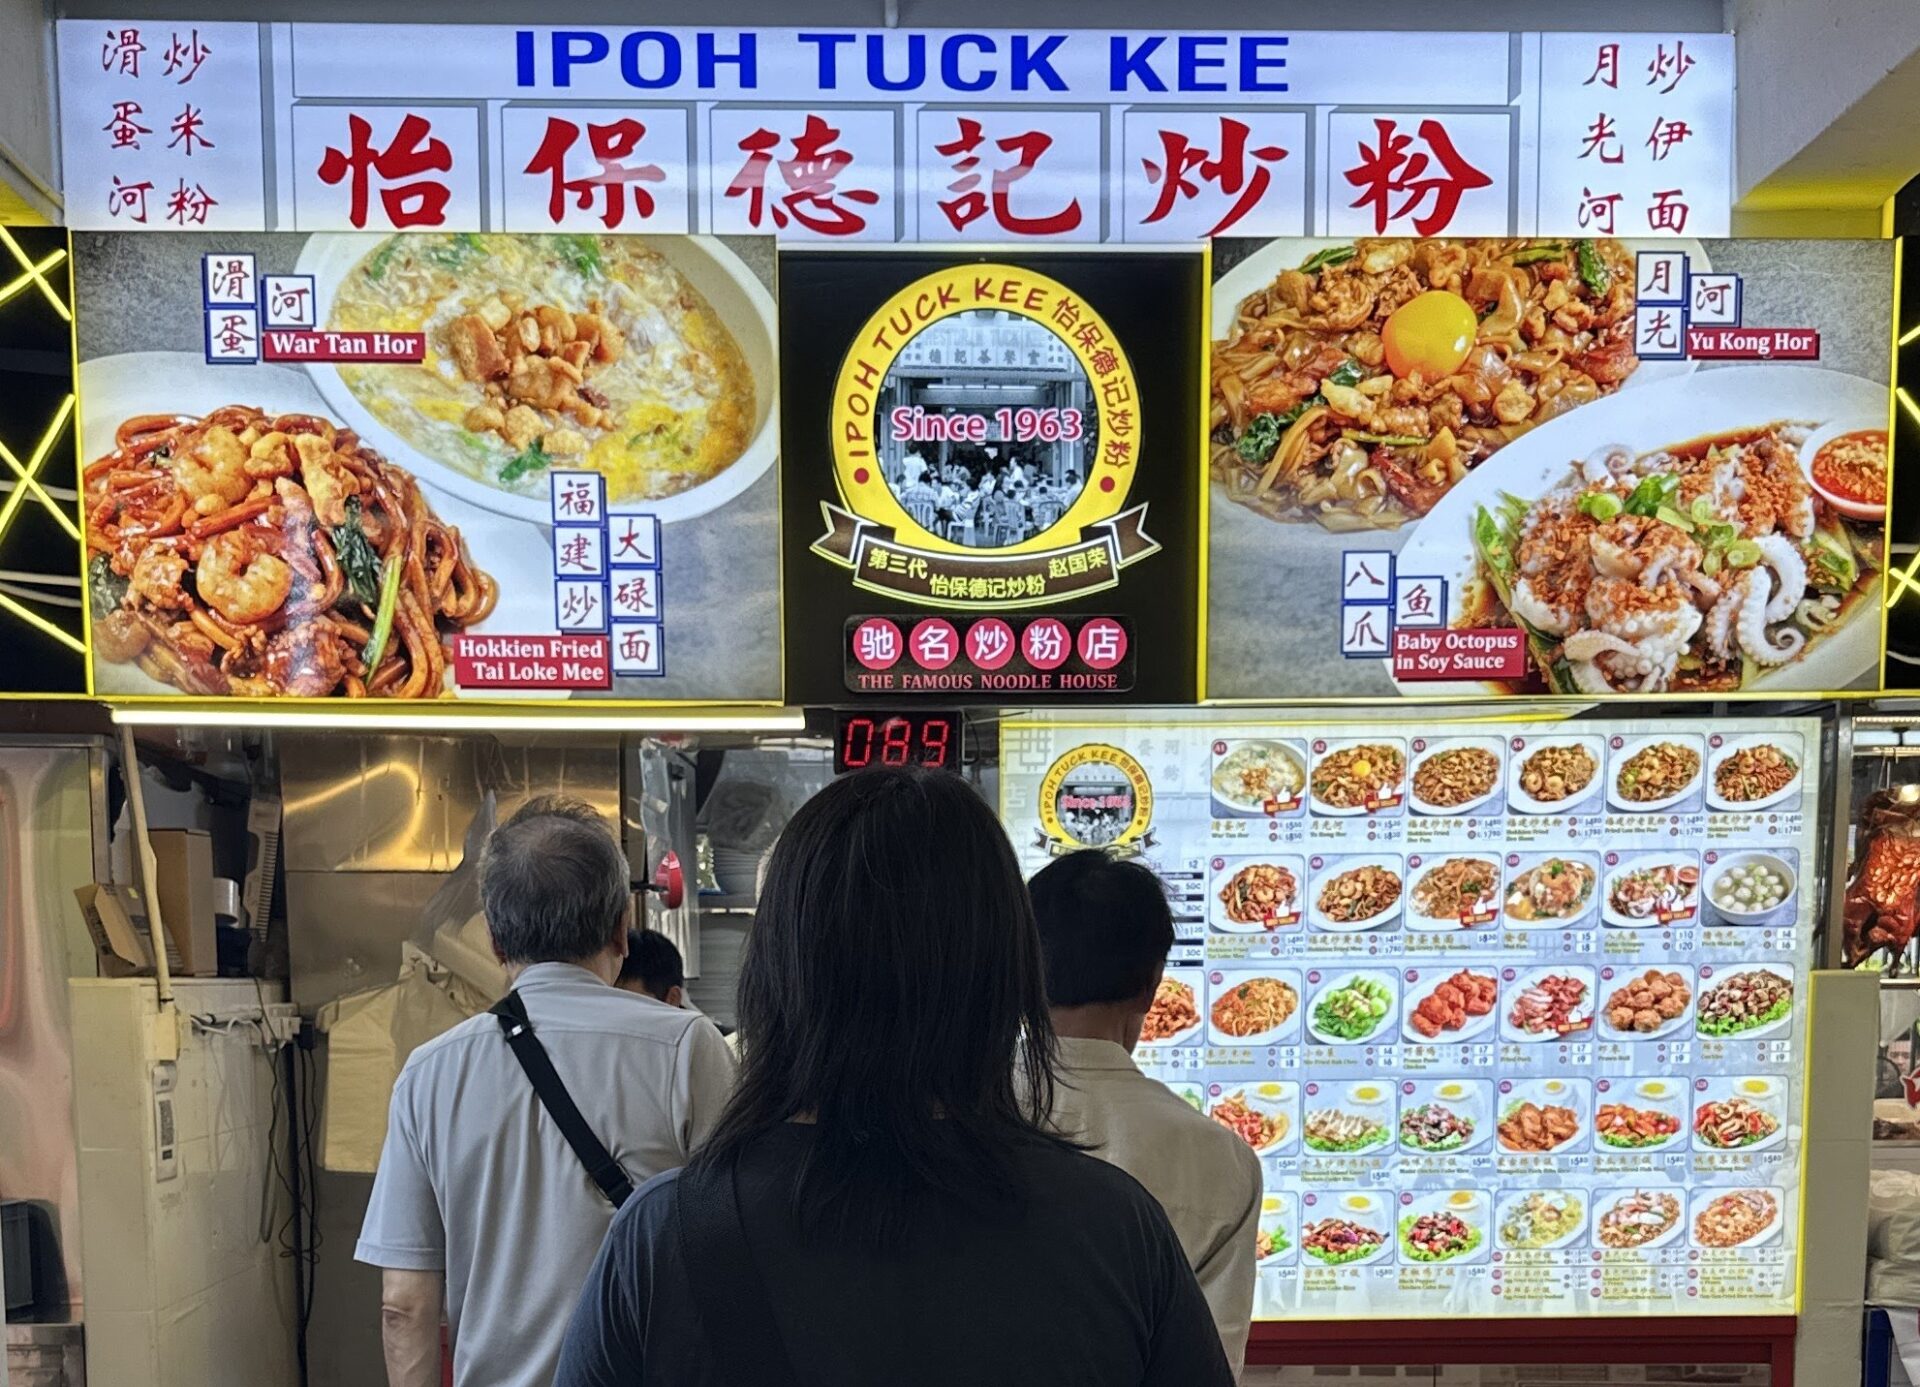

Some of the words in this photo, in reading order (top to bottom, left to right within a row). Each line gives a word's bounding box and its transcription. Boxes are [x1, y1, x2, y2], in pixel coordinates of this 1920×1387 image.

[516, 30, 757, 90] IPOH
[798, 33, 1070, 92] TUCK
[1109, 36, 1289, 92] KEE
[102, 30, 154, 225] 滑蛋河
[163, 28, 219, 225] 炒米粉
[1577, 43, 1624, 235] 月光河
[1645, 40, 1696, 235] 炒伊面
[318, 112, 1494, 238] 怡保德記炒粉
[211, 259, 256, 355] 滑蛋
[271, 282, 310, 323] 河
[1641, 259, 1678, 349] 月光
[1695, 279, 1732, 316] 河
[271, 332, 320, 355] War
[324, 332, 370, 355] Tan
[373, 333, 418, 355] Hor
[1690, 332, 1714, 350] Yu
[1719, 332, 1771, 355] Kong
[1774, 332, 1813, 350] Hor
[845, 358, 881, 458] IPOH
[872, 282, 961, 353] TUCK
[974, 277, 1049, 312] KEE
[1051, 296, 1134, 470] 怡保德记炒粉
[891, 406, 987, 442] Since
[996, 407, 1082, 442] 1963
[559, 479, 599, 626] 福建炒
[868, 547, 929, 579] 第三代
[1048, 546, 1109, 579] 赵国荣
[613, 518, 654, 664] 大碌面
[930, 574, 1046, 599] 怡保德记炒粉
[1346, 560, 1385, 647] 八爪
[1401, 583, 1434, 619] 鱼
[459, 639, 546, 659] Hokkien
[550, 639, 603, 659] Fried
[860, 624, 1120, 662] 驰名炒粉店
[1397, 634, 1442, 654] Baby
[1445, 634, 1517, 653] Octopus
[472, 662, 504, 682] Tai
[509, 662, 558, 681] Loke
[562, 662, 604, 682] Mee
[858, 674, 894, 689] THE
[902, 674, 973, 689] FAMOUS
[981, 674, 1052, 689] NOODLE
[1060, 673, 1118, 689] HOUSE
[1396, 654, 1414, 670] in
[1418, 654, 1451, 674] Soy
[1453, 655, 1505, 670] Sauce
[843, 718, 950, 768] 089
[1055, 751, 1086, 777] TUCK
[1091, 748, 1117, 762] KEE
